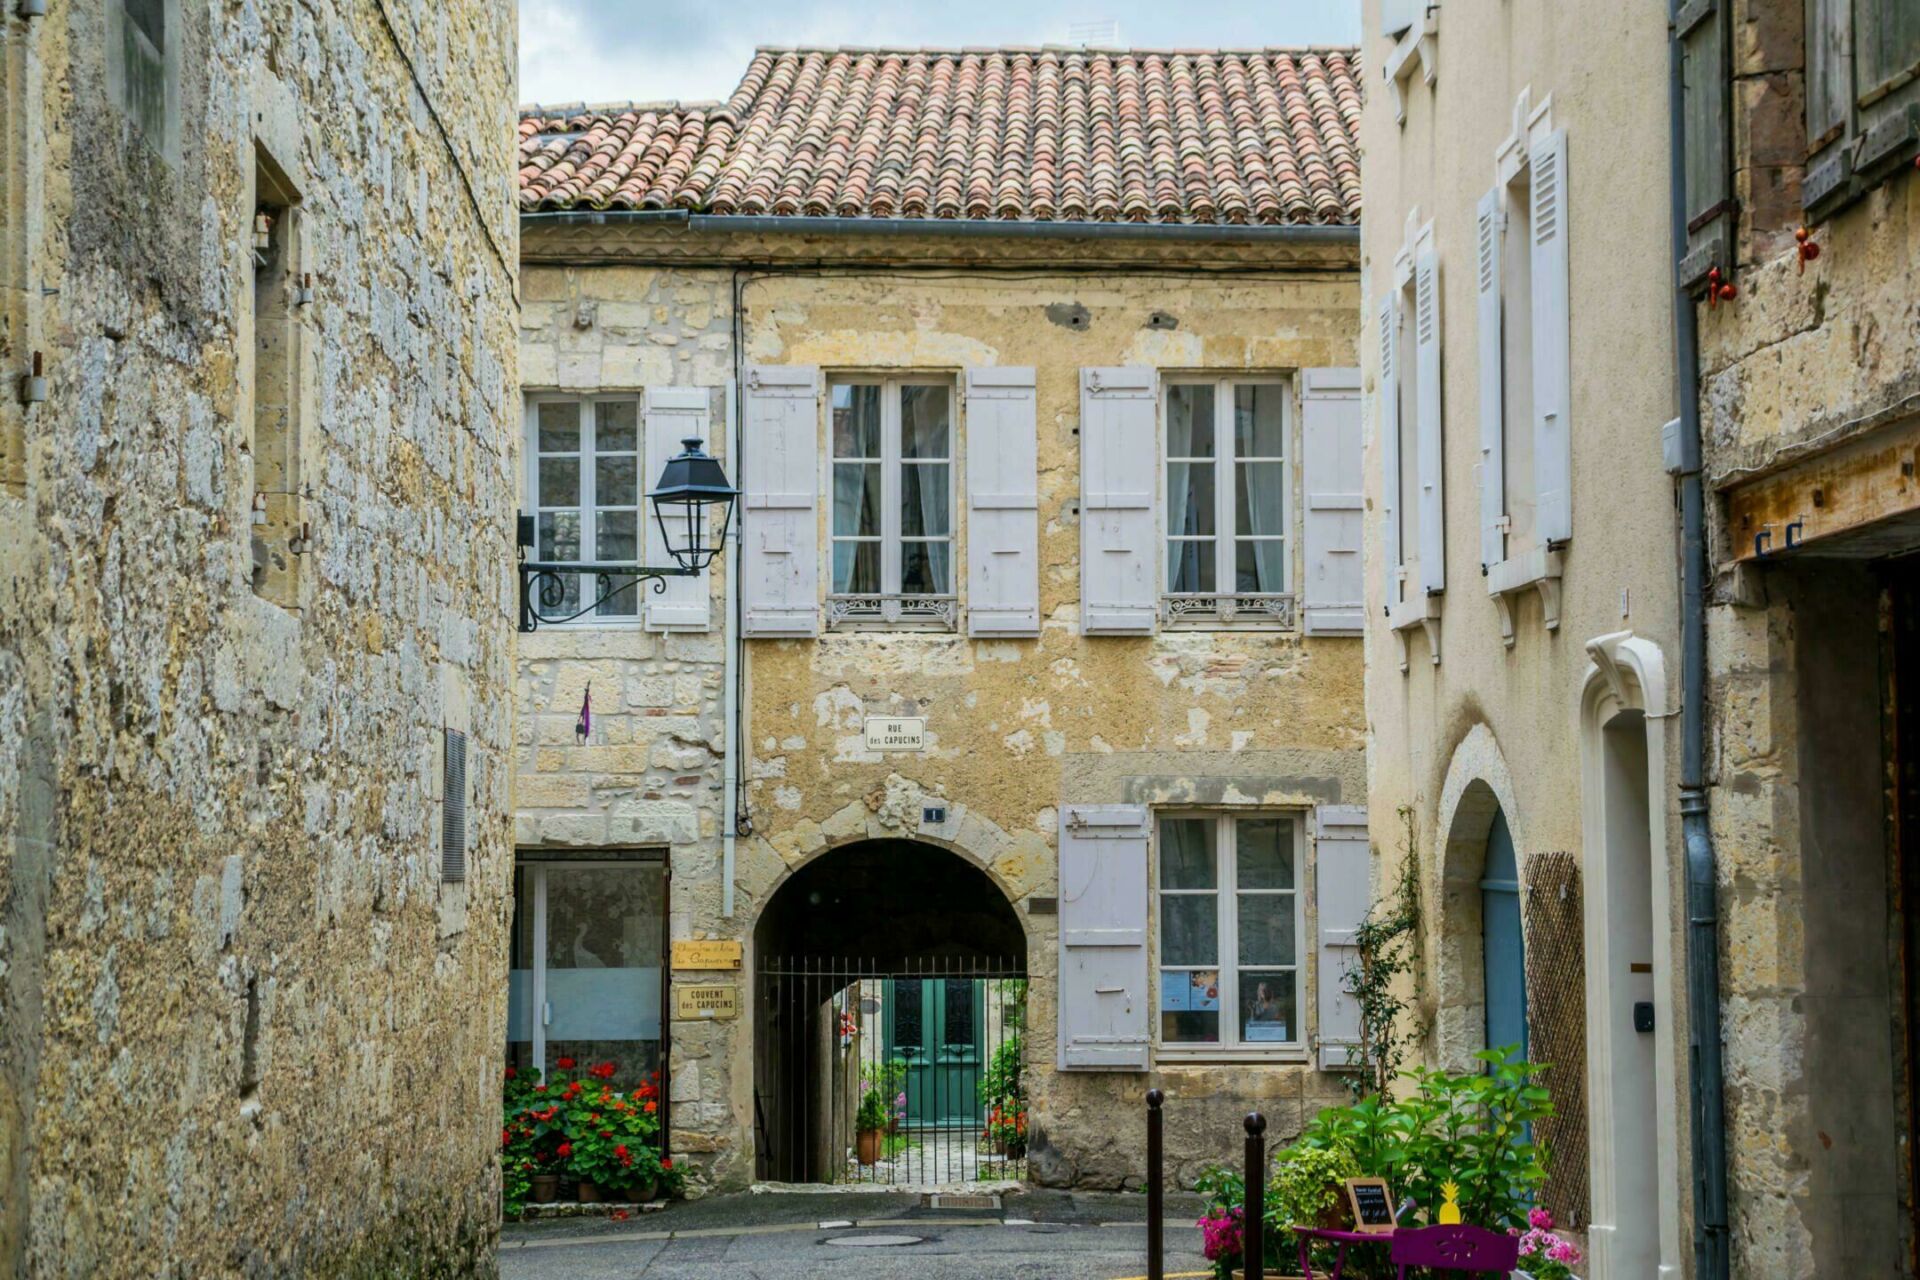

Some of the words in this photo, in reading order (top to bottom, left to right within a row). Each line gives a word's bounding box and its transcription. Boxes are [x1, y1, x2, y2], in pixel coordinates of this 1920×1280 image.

[888, 724, 902, 733] RUE
[884, 735, 921, 745] CAPUCINS
[691, 990, 723, 999] COUVENT
[682, 1000, 693, 1009] des
[697, 1000, 733, 1009] CAPUCINS
